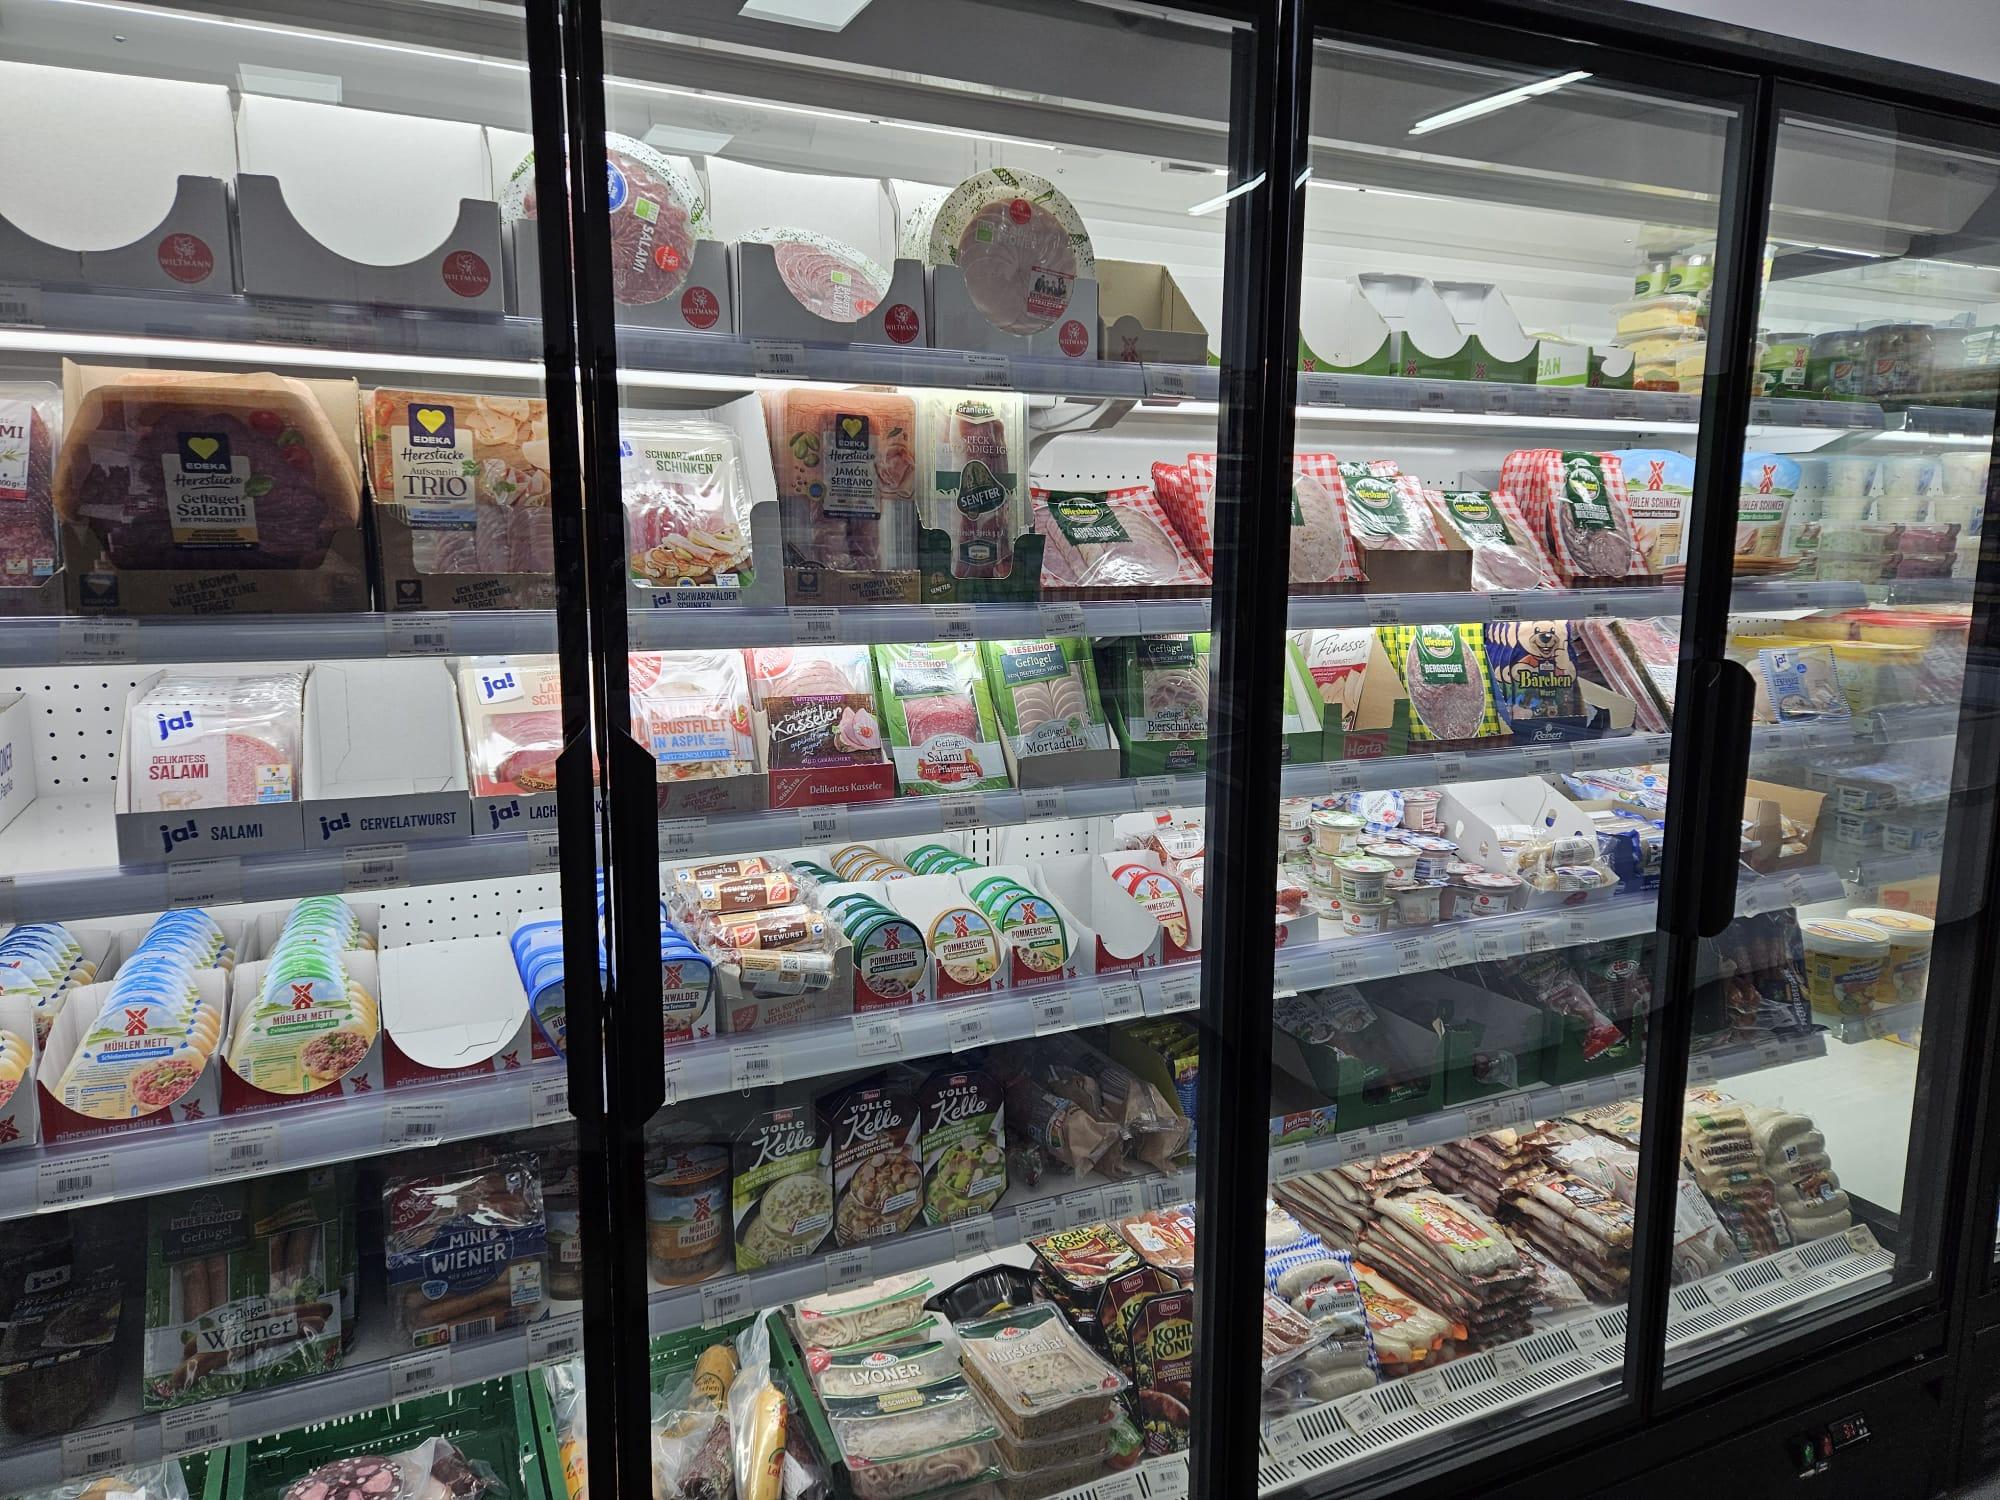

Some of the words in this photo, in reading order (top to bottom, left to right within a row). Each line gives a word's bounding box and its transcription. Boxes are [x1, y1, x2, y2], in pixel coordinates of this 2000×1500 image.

[632, 224, 655, 274] SALAMI
[1537, 357, 1561, 377] GAN
[957, 404, 993, 415] GranTerre
[413, 436, 451, 445] EDEKA
[838, 440, 866, 448] EDEKA
[962, 435, 990, 446] SPECK
[400, 448, 464, 462] Herzstücke
[645, 450, 723, 463] SCHWARZWÄLDER
[829, 450, 875, 462] Herzstücke
[185, 462, 227, 471] EDEKA
[410, 467, 457, 476] Aufschnitt
[656, 460, 714, 475] SCHINKEN
[835, 465, 869, 477] JAMÓN
[173, 473, 243, 488] Herzstücke
[403, 475, 467, 497] TRIO
[831, 477, 873, 487] SERRANO
[181, 494, 240, 505] Geflügel
[961, 488, 1001, 508] SENFTER
[1650, 497, 1681, 509] SCHINKEN
[1759, 499, 1784, 511] SCHINKEN
[176, 504, 247, 517] Salami
[199, 573, 239, 589] KOMM
[456, 585, 471, 594] ICH
[473, 579, 500, 592] KOMM
[848, 582, 861, 592] ICH
[863, 579, 885, 589] KOMM
[653, 592, 672, 608] ja!
[677, 591, 737, 601] SCHWARZWÄLDER
[1007, 643, 1055, 654] WIESENHOF
[1148, 642, 1184, 654] Geflügel
[1314, 634, 1366, 659] Finesse
[896, 660, 947, 669] WIESENHOF
[1015, 653, 1052, 668] Geflügel
[1424, 663, 1463, 673] BERGSTEIGER
[1774, 653, 1787, 669] ja!
[482, 672, 516, 699] ja!
[1519, 670, 1573, 689] Bärchen
[771, 706, 842, 736] Kasseler
[1157, 710, 1184, 721] Geflügel
[157, 710, 194, 741] ja!
[652, 719, 726, 735] BRUSTFILET
[1147, 719, 1206, 733] Bierschinken
[1038, 728, 1066, 740] Geflügel
[1532, 729, 1563, 742] Reinert
[654, 736, 667, 749] IN
[671, 735, 705, 748] ASPIK
[935, 737, 966, 749] Geflügel
[1026, 737, 1084, 754] Mortadella
[1347, 741, 1383, 756] Herta
[152, 754, 206, 765] DELIKATESS
[927, 750, 963, 763] Salami
[149, 763, 209, 781] SALAMI
[810, 784, 849, 795] Delikatess
[851, 781, 882, 792] Kasseler
[488, 800, 521, 830] ja!
[529, 804, 557, 820] LACH
[319, 812, 350, 841] ja!
[360, 811, 457, 831] CERVELATWURST
[159, 819, 199, 854] ja!
[210, 823, 263, 841] SALAMI
[698, 865, 738, 877] TEEWURST
[723, 883, 765, 894] TEEWURST
[1145, 899, 1176, 911] MMERSCHE
[762, 930, 805, 942] TEEWURST
[1011, 925, 1053, 938] POMMERSCHE
[943, 938, 985, 953] POMMERSCHE
[869, 951, 916, 966] POMMERSCHE
[663, 991, 699, 1003] ENWALDER
[767, 1006, 781, 1017] ICH
[783, 997, 806, 1009] KOMM
[273, 1012, 308, 1026] MÜHLEN
[311, 1009, 334, 1020] METT
[103, 1041, 140, 1052] MÜHLEN
[143, 1037, 168, 1049] METT
[937, 1084, 978, 1099] VOLLE
[850, 1099, 893, 1115] VOLLE
[928, 1094, 988, 1134] Kelle
[759, 1119, 805, 1136] VOLLE
[840, 1108, 902, 1151] Kelle
[748, 1128, 815, 1170] Kelle
[1785, 1146, 1797, 1161] ja!
[181, 1226, 232, 1244] Geflügel
[689, 1221, 715, 1234] MÜHLEN
[450, 1229, 487, 1249] MINI
[1051, 1227, 1090, 1244] KOHL
[1054, 1233, 1099, 1250] KÖNIG
[431, 1242, 507, 1275] WIENER
[1122, 1276, 1142, 1291] Meica
[217, 1302, 267, 1324] Geflügel
[1160, 1302, 1180, 1314] Meica
[1318, 1300, 1355, 1312] Weißwurst
[201, 1318, 294, 1350] Wiener
[986, 1335, 1068, 1365] Wurstsalat
[850, 1363, 923, 1386] LYONER
